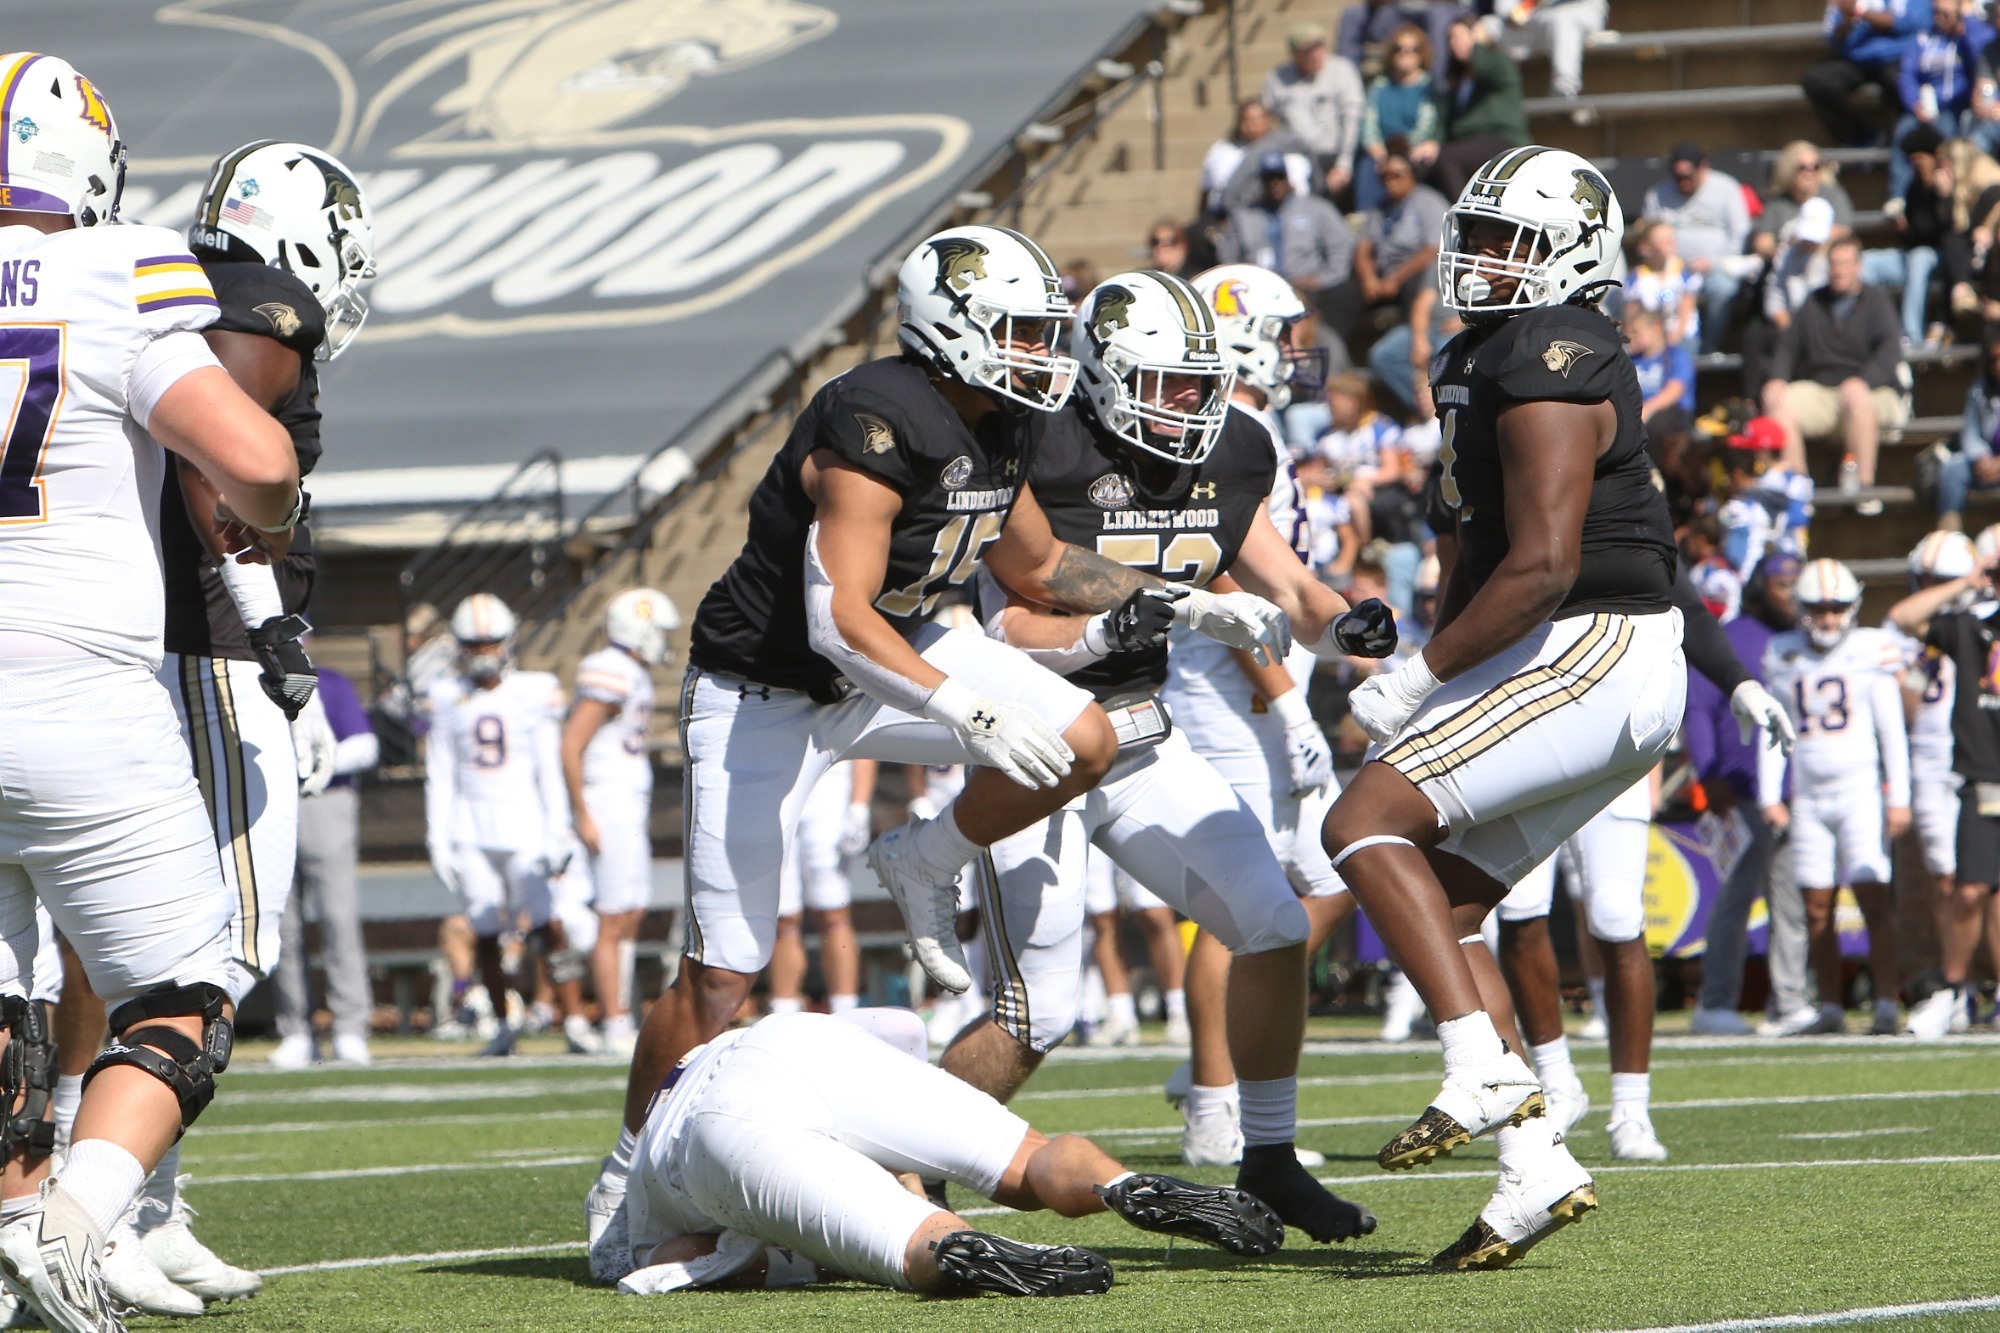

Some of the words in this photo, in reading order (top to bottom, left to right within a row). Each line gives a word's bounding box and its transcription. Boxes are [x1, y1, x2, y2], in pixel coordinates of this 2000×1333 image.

[0, 187, 12, 206] E
[191, 227, 229, 251] ddell
[1102, 508, 1219, 530] LINDENWOOD
[1795, 675, 1848, 734] 13
[473, 712, 506, 769] 9
